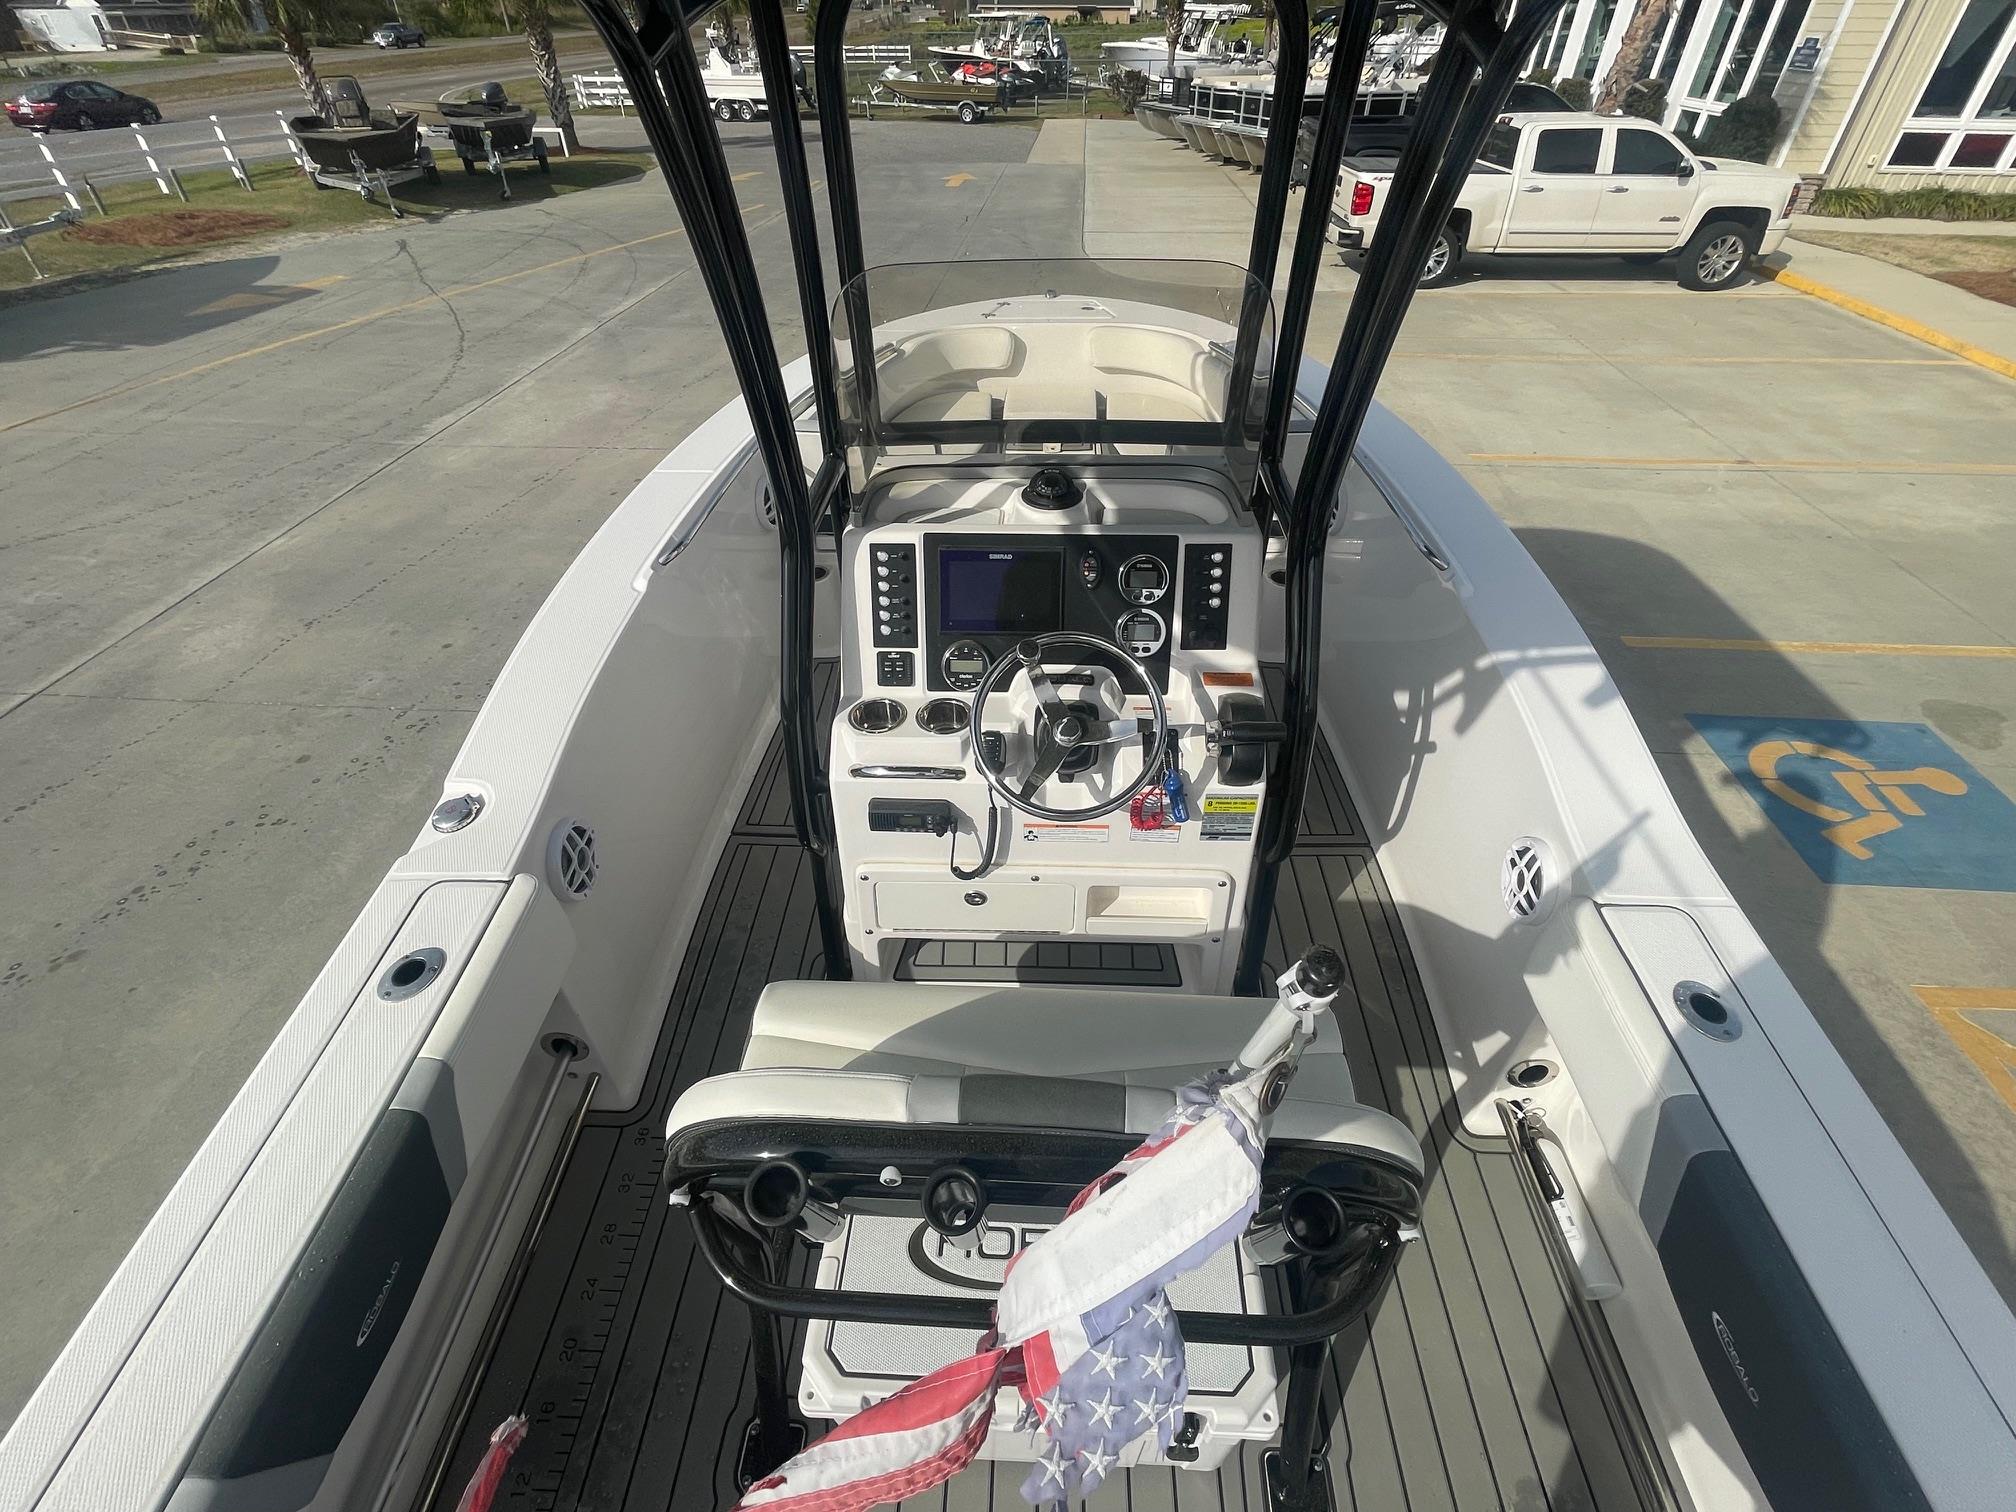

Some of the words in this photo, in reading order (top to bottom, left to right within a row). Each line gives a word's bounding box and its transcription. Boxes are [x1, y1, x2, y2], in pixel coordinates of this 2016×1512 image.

[633, 1127, 650, 1147] 36
[618, 1173, 634, 1193] 32
[600, 1223, 617, 1245] 28
[580, 1277, 599, 1301] 24
[559, 1337, 578, 1362] 20
[536, 1401, 556, 1424] 16
[510, 1471, 532, 1498] 12
